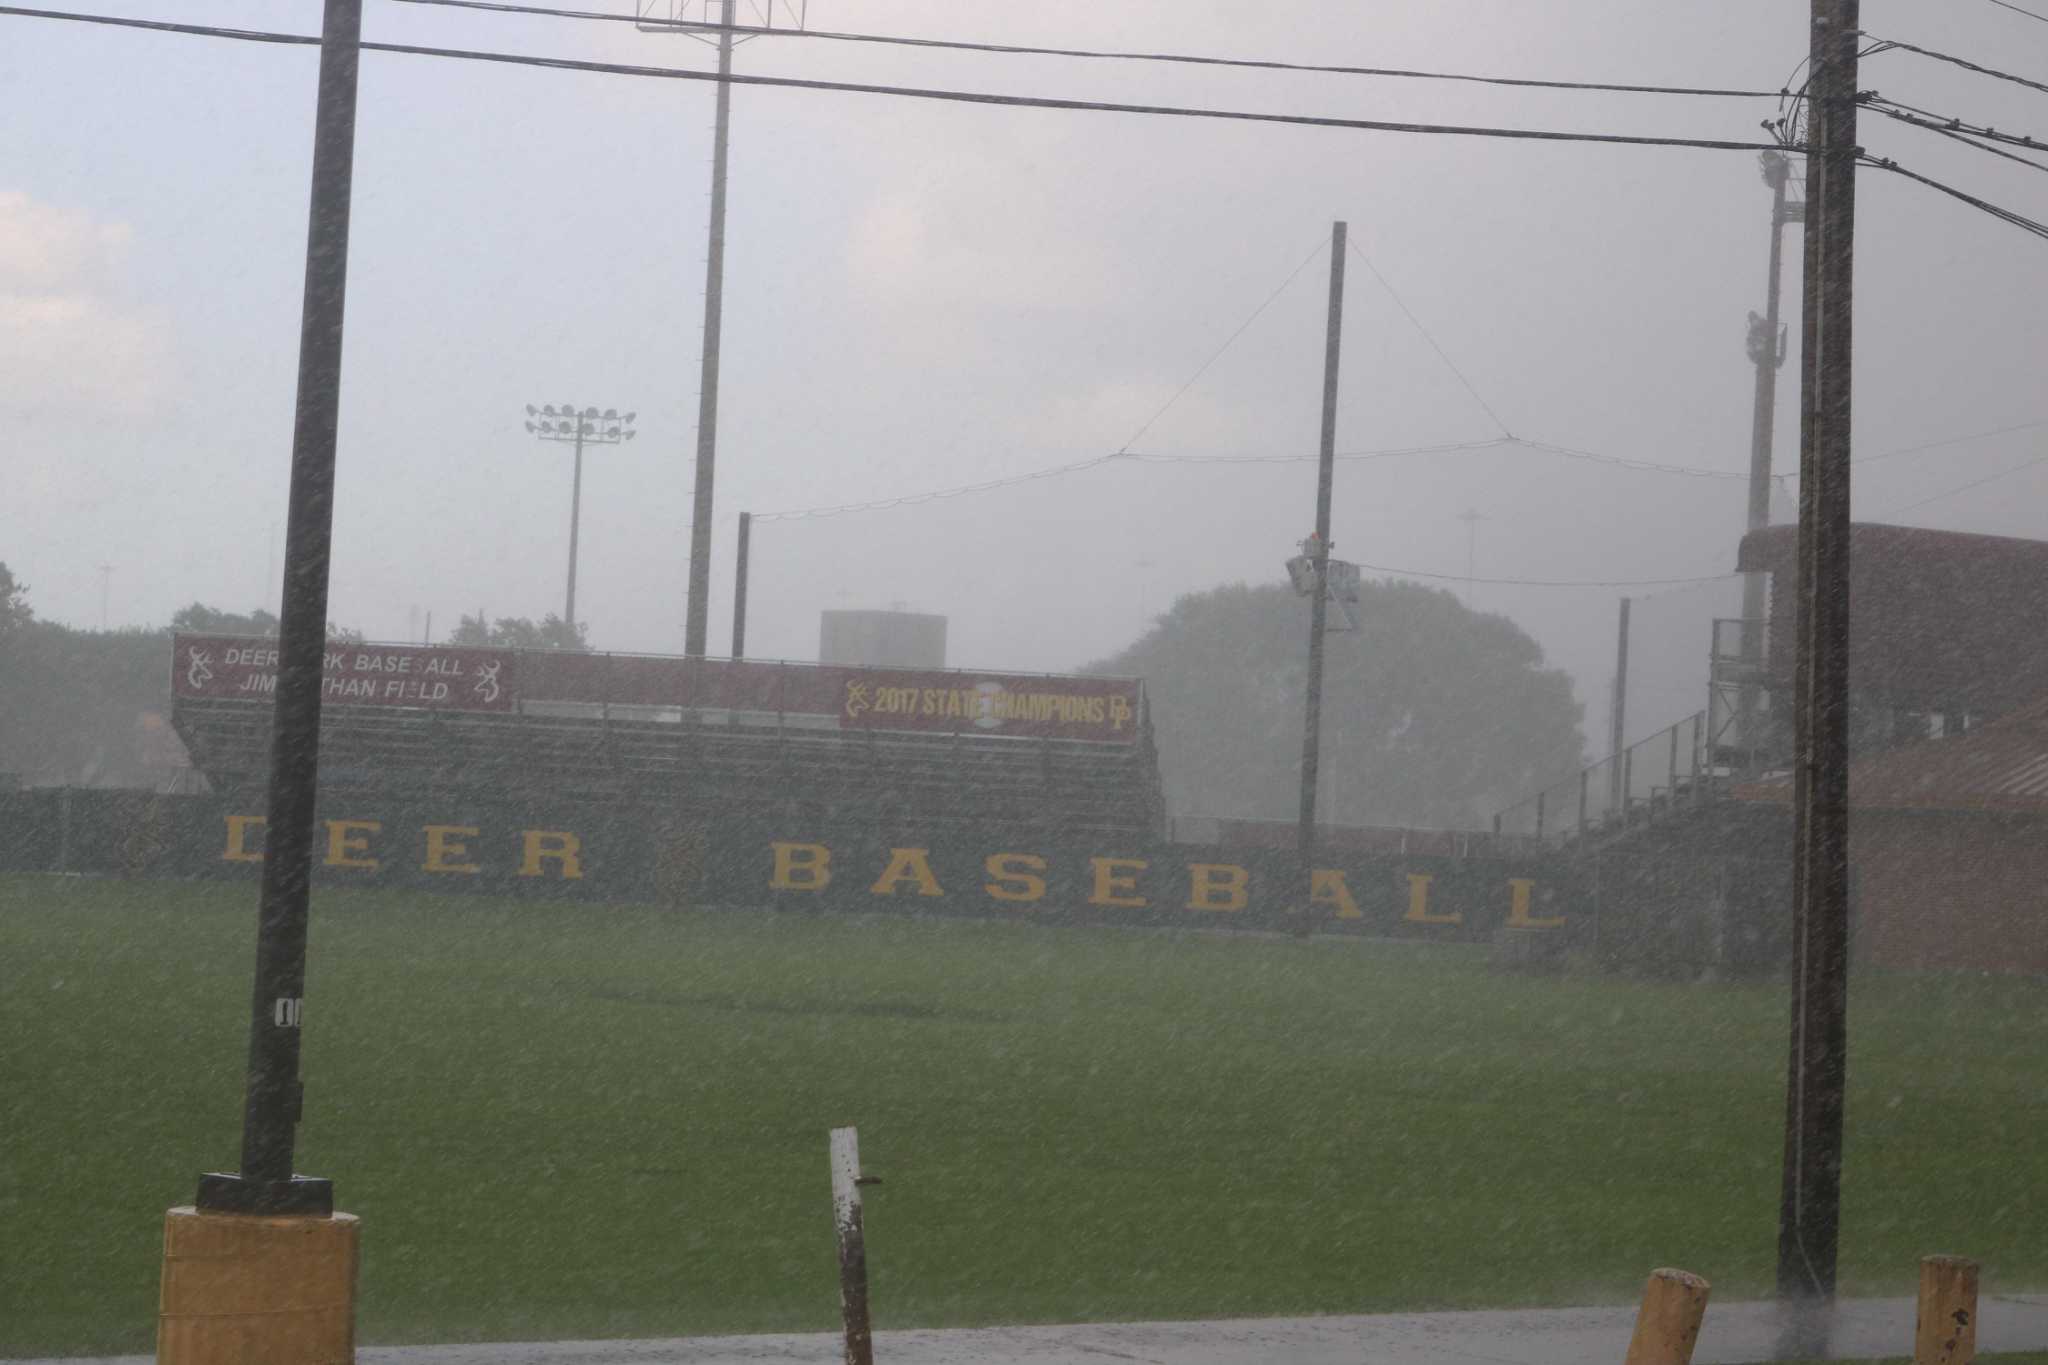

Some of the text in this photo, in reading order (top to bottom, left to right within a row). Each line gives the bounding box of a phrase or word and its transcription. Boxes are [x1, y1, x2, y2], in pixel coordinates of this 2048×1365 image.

[225, 649, 279, 666] DEER
[322, 653, 345, 671] RK
[874, 688, 918, 714] 2017
[923, 689, 983, 717] STATE
[991, 692, 1104, 723] CHAMPIONS
[223, 815, 1567, 929] DEER BASEBALL
